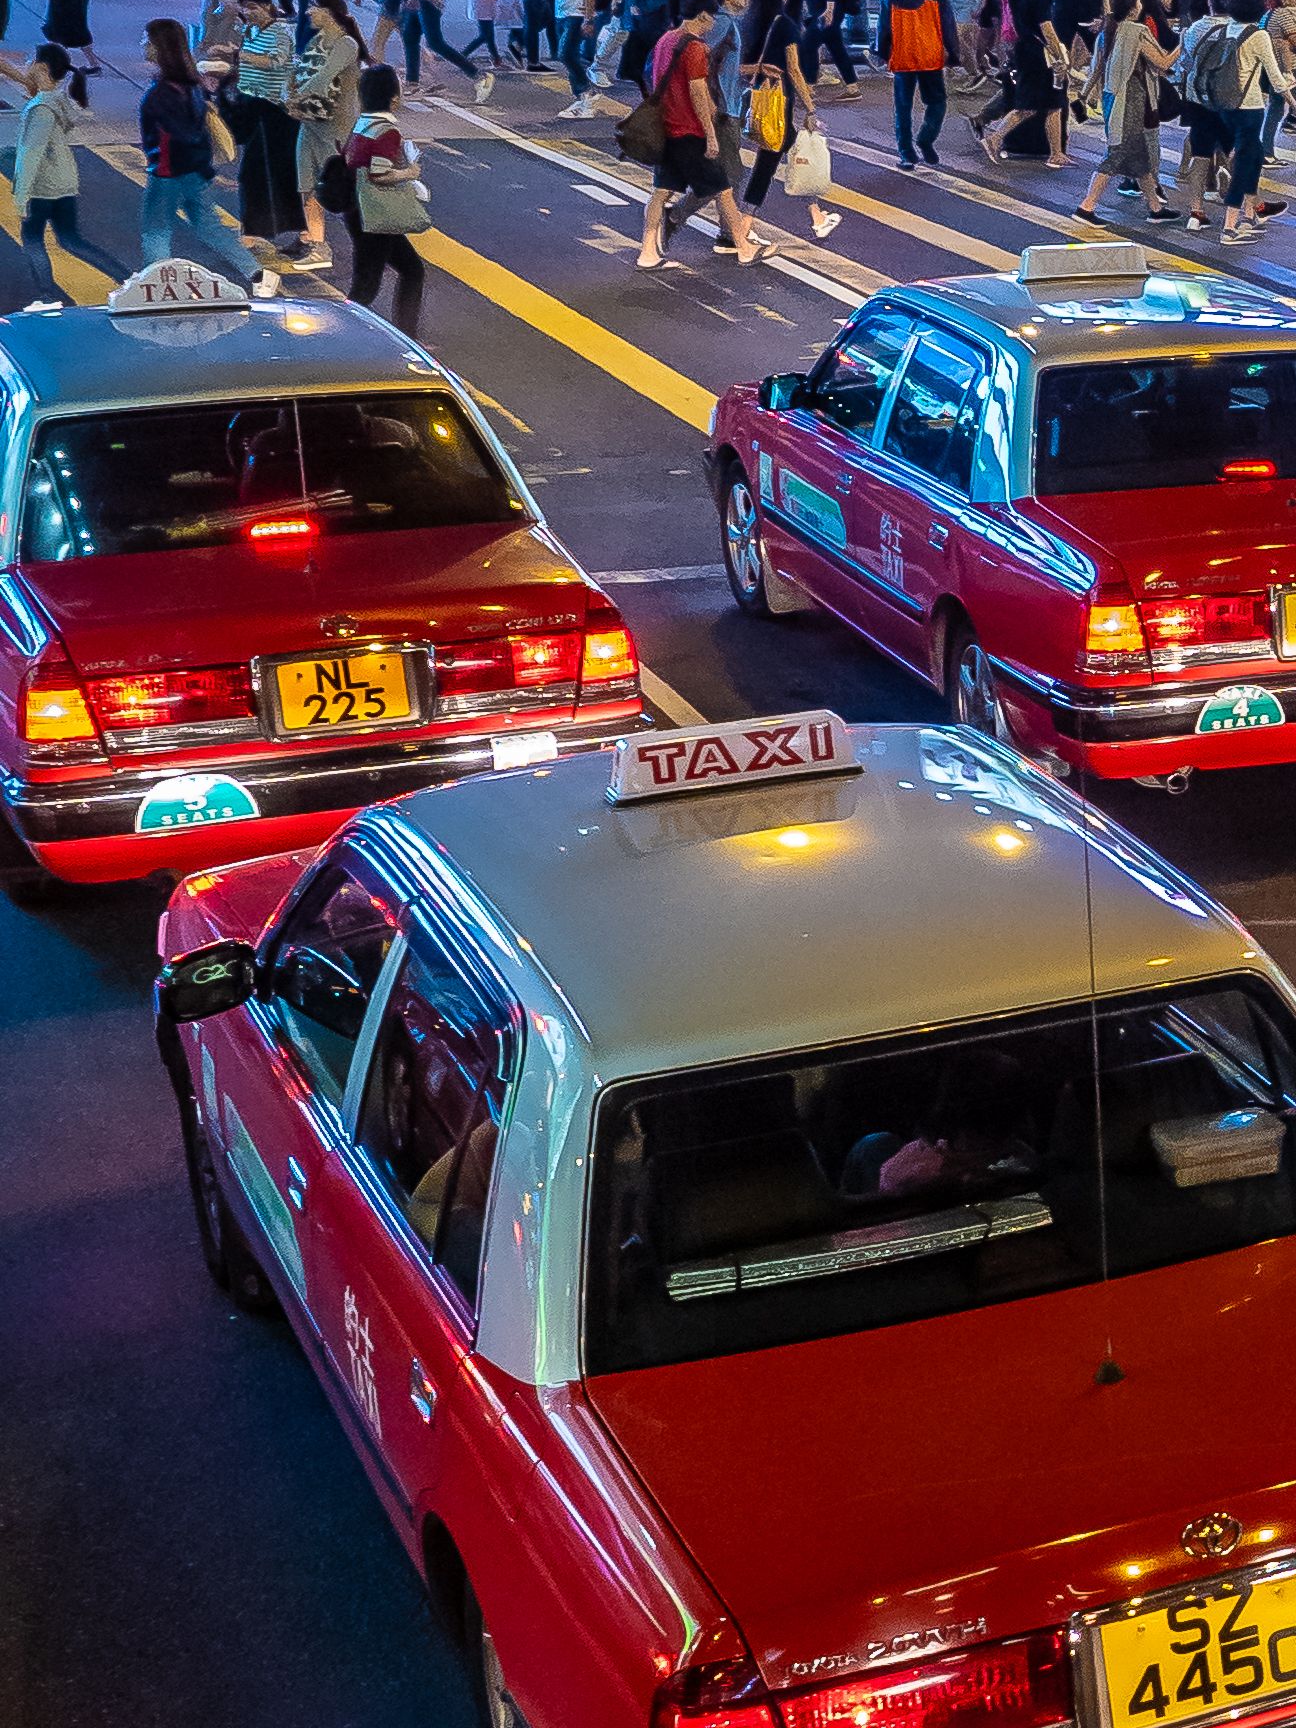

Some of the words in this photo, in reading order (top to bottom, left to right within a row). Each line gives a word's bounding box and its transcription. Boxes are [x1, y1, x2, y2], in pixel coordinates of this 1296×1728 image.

[159, 265, 198, 284] 的士
[141, 279, 222, 304] TAXI
[315, 659, 370, 690] NL
[302, 690, 388, 726] 225
[1232, 697, 1250, 718] 4
[1211, 715, 1271, 731] SEATS
[638, 723, 834, 785] TAXI
[160, 807, 234, 826] SEATS
[1167, 1584, 1260, 1656] SZ
